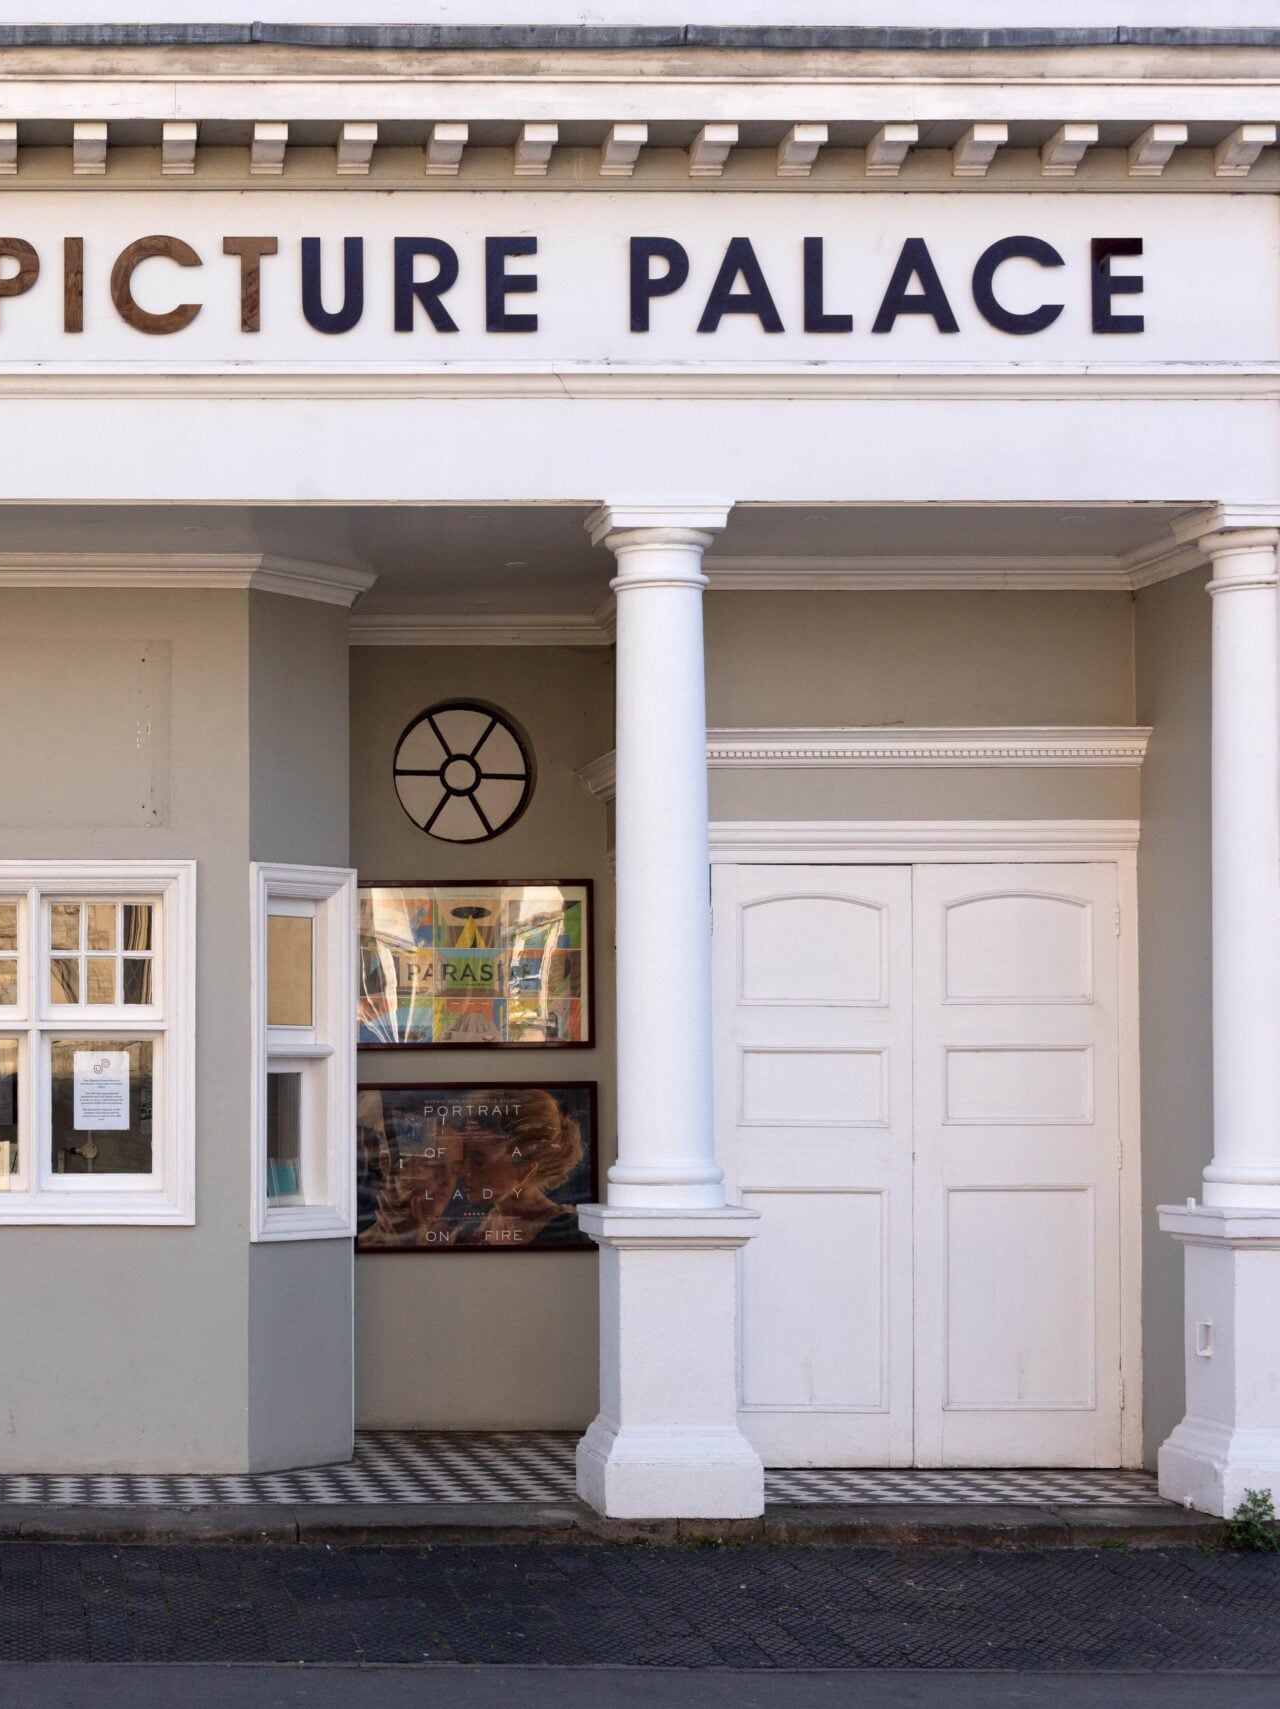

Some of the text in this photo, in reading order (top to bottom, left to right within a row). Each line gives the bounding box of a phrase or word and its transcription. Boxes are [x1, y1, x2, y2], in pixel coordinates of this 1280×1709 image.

[629, 235, 1145, 336] PALACE
[424, 1105, 522, 1117] PORTRAIT
[425, 1147, 522, 1158] OF A
[425, 1188, 523, 1201] LADY
[425, 1230, 523, 1242] ON FIRE
